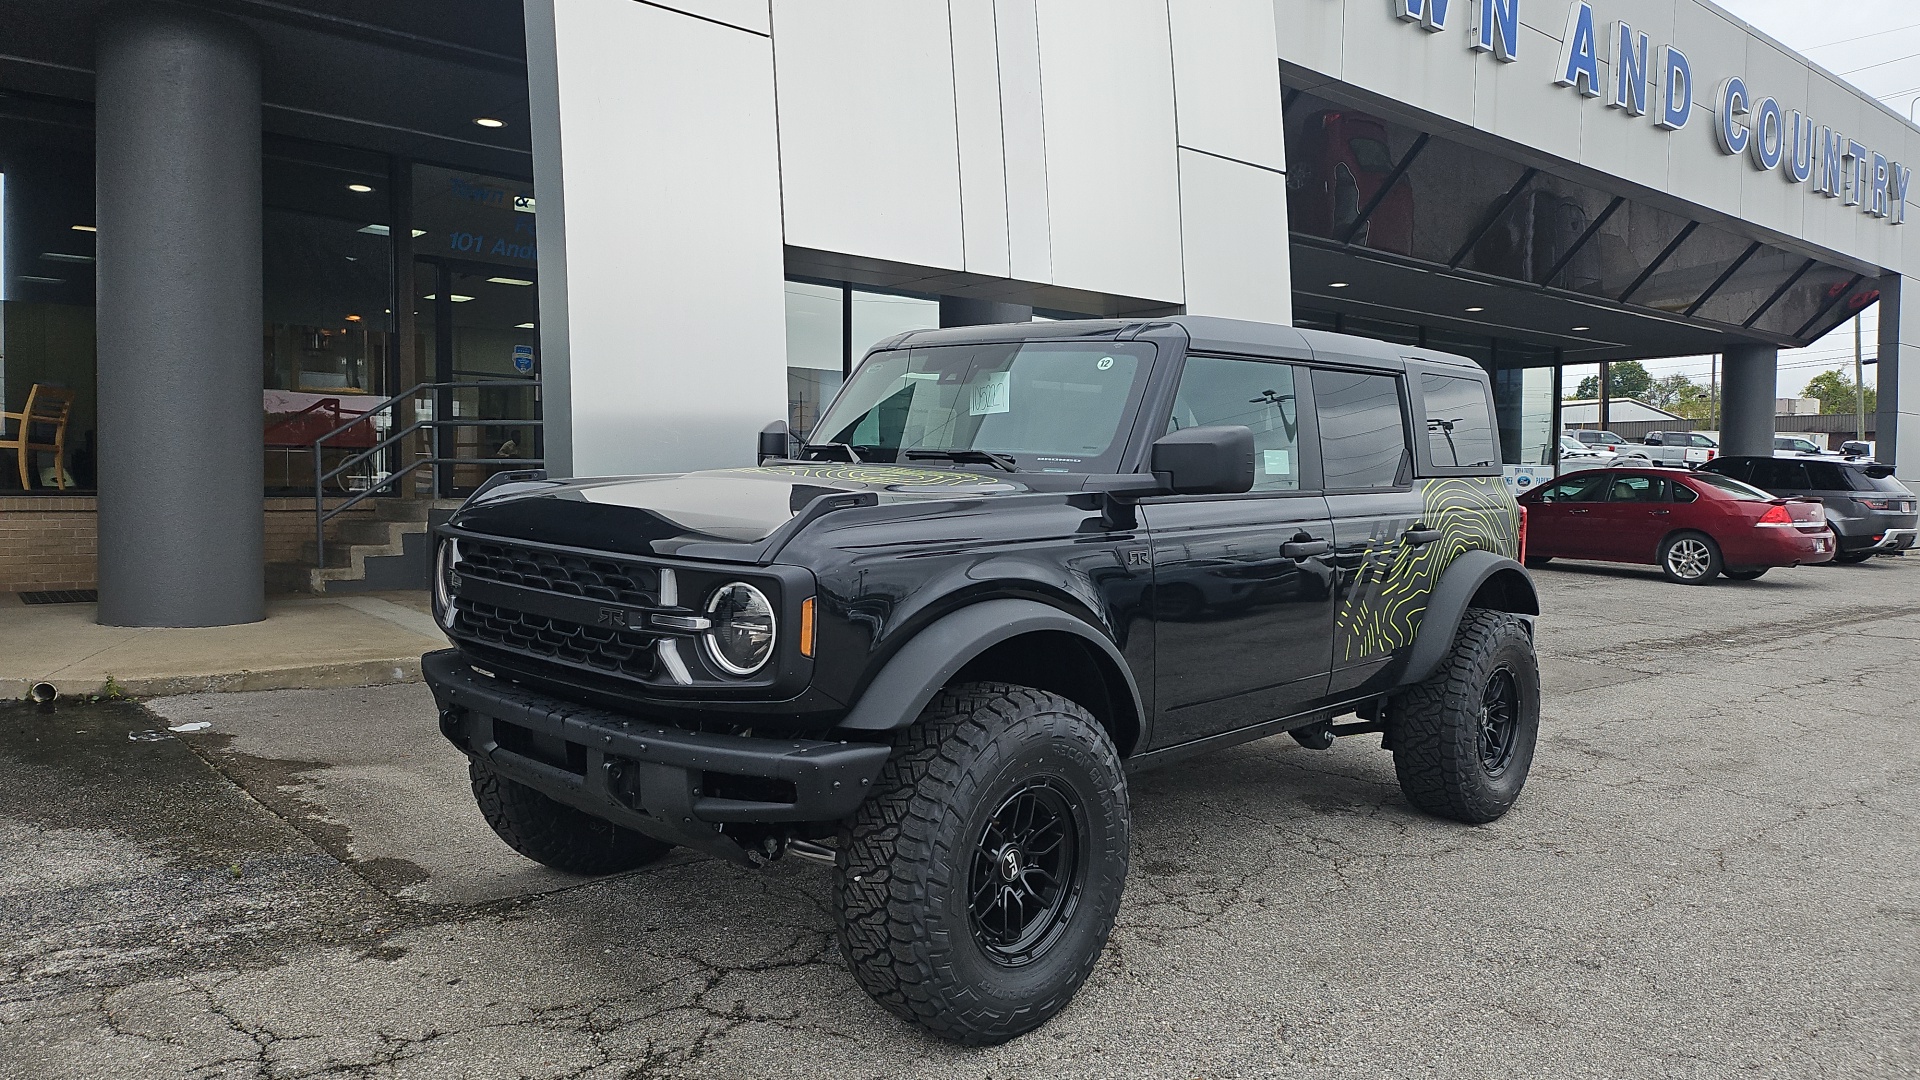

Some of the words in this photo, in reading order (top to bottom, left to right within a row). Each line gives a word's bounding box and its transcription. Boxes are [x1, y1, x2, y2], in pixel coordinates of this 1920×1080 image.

[1556, 0, 1693, 130] AND
[1715, 76, 1912, 223] COUNTRY
[450, 231, 484, 253] 101
[1100, 359, 1111, 368] 12
